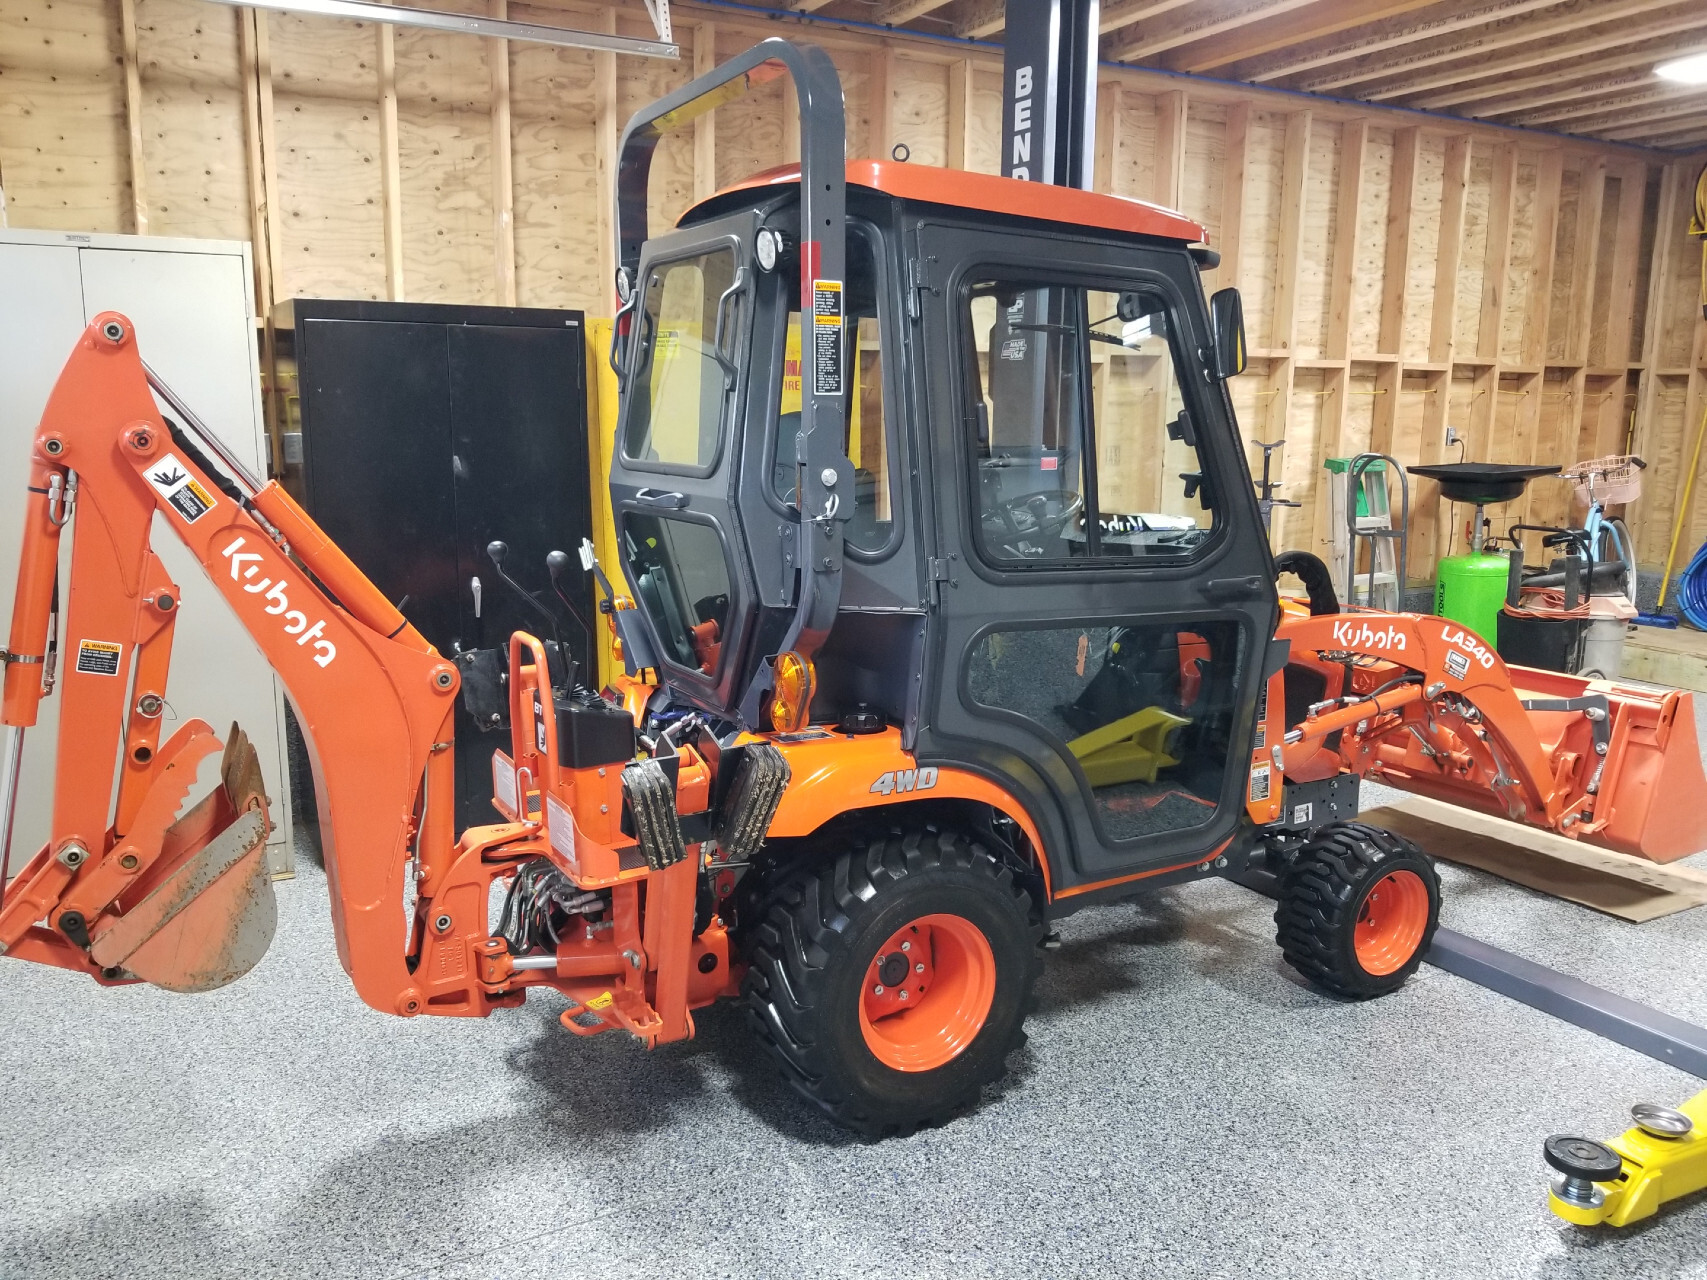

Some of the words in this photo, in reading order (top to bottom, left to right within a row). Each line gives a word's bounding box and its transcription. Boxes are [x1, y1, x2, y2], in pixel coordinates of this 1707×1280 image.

[221, 536, 337, 669] Kubota
[91, 643, 118, 651] WARNING
[1333, 620, 1406, 650] Kubota
[1440, 625, 1495, 669] LA340
[869, 766, 939, 796] 4WD
